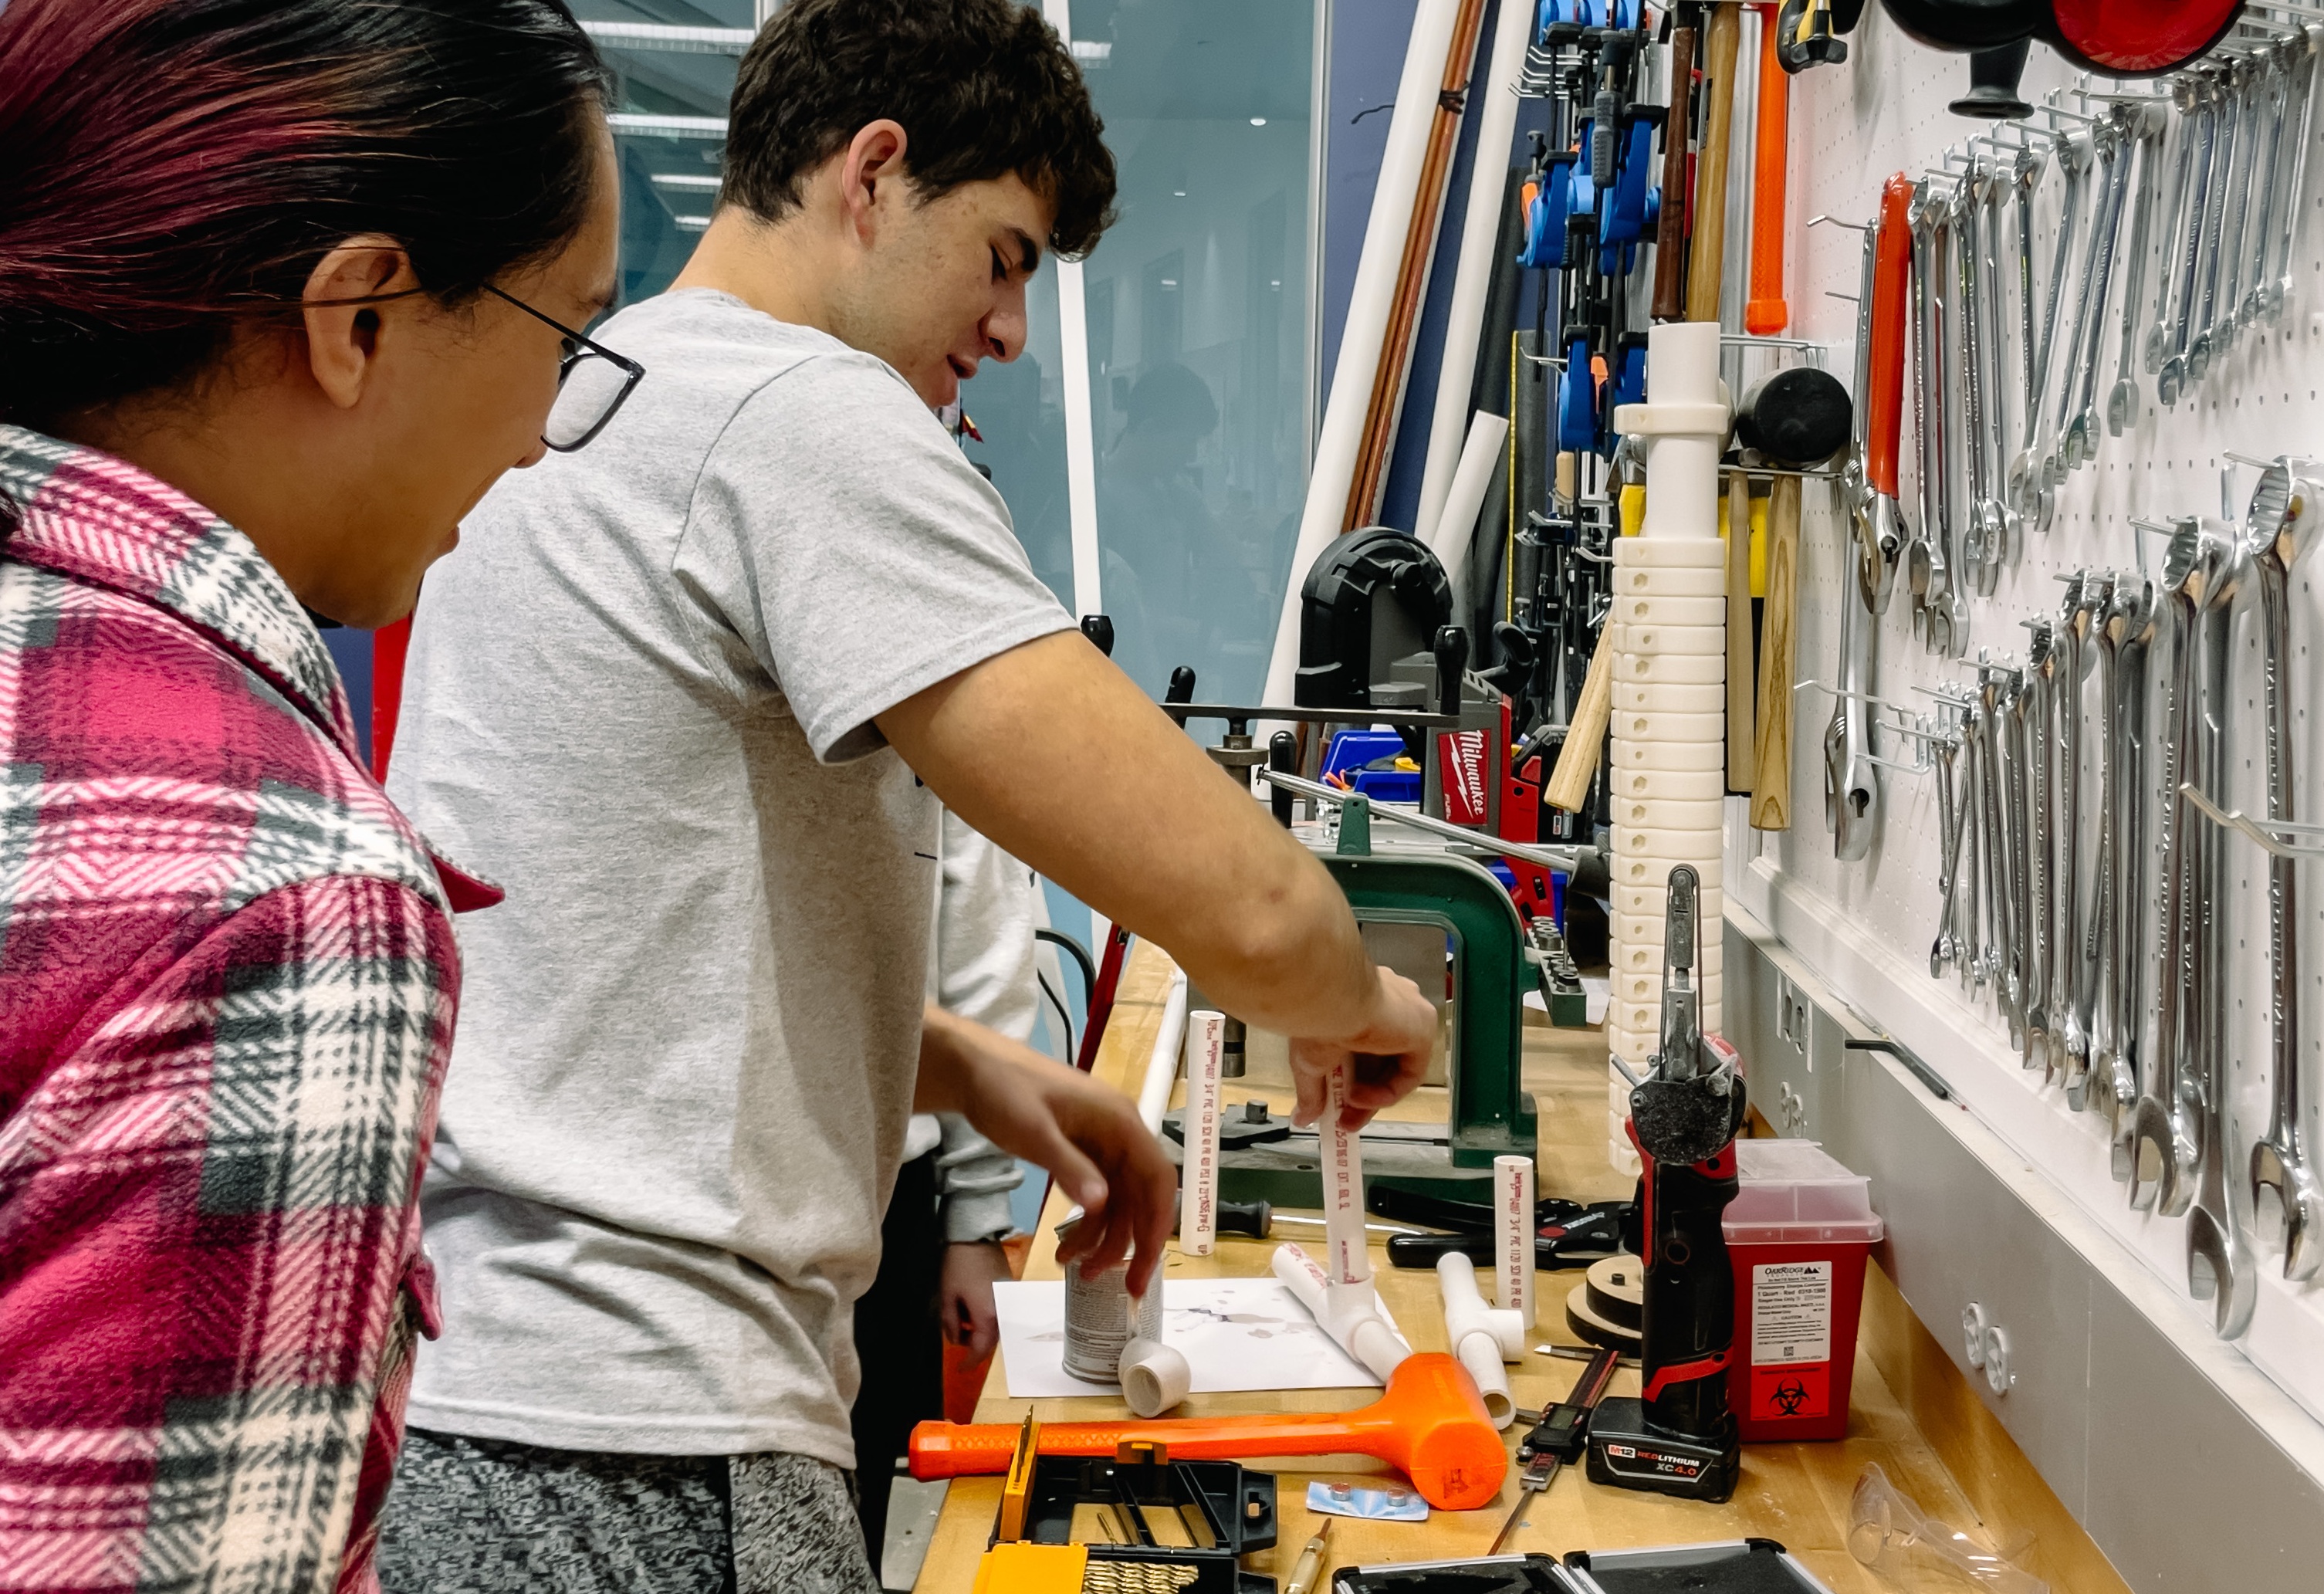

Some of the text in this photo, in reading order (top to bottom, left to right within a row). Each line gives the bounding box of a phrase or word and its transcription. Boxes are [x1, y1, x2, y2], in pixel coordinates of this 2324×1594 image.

[1459, 729, 1484, 816] Milwaukee
[1203, 1098, 1214, 1108] PVC
[1510, 1235, 1521, 1246] PVC
[1510, 1250, 1521, 1262] 1120
[1510, 1265, 1521, 1276] SCH
[1610, 1445, 1633, 1456] M12
